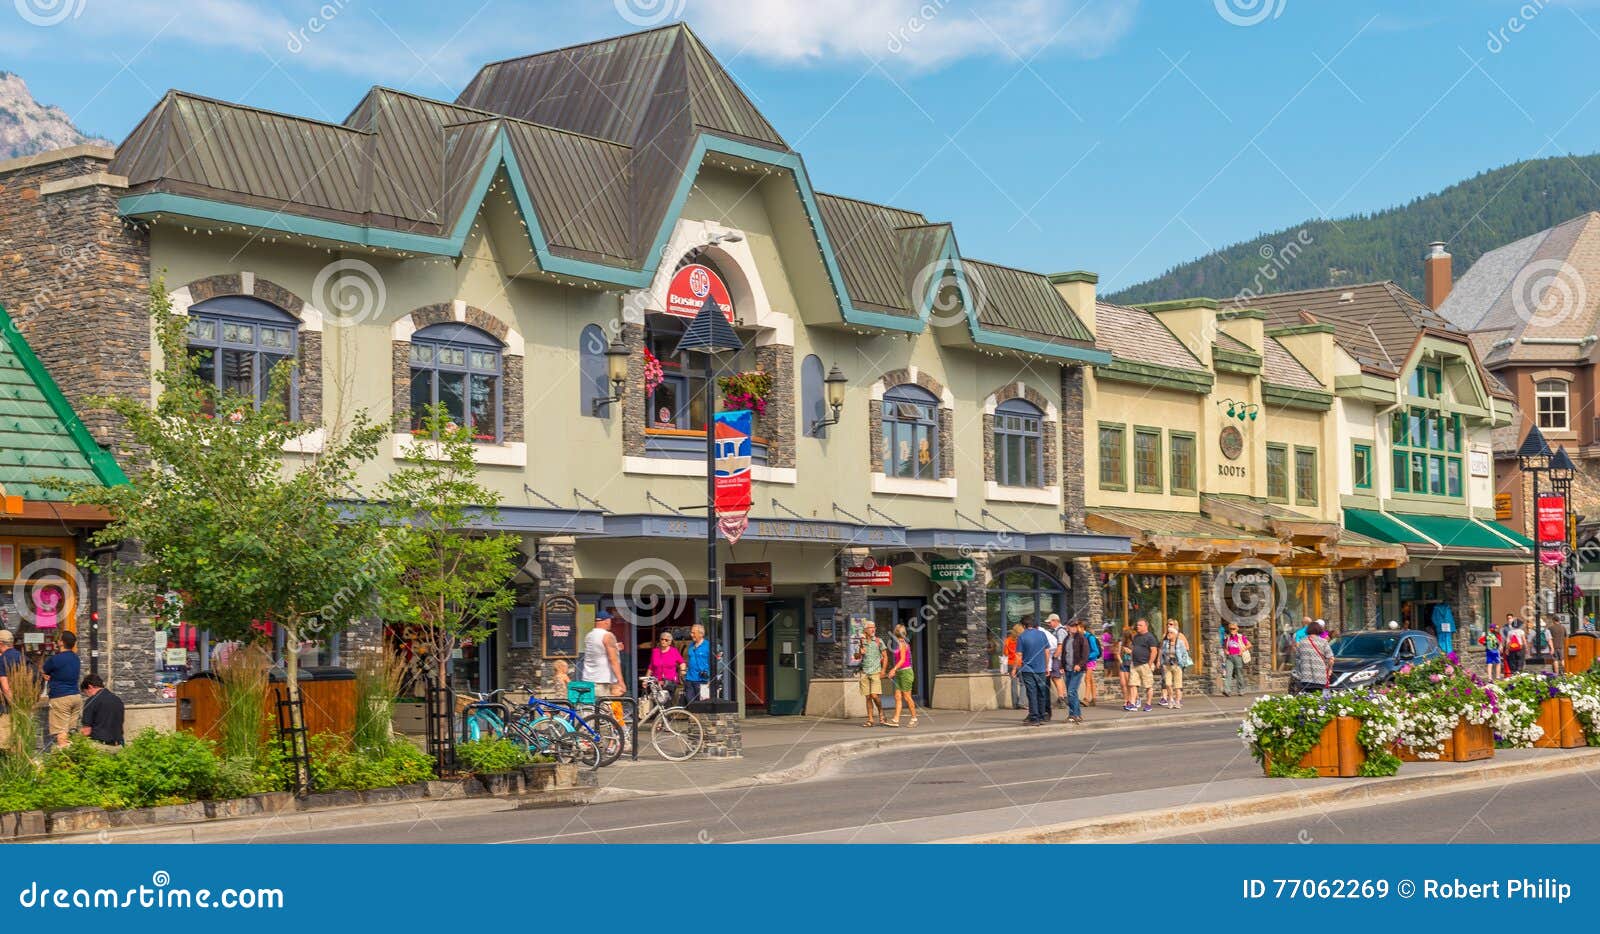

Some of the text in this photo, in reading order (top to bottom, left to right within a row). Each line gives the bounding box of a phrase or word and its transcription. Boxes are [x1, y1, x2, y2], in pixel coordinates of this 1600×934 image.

[670, 294, 704, 308] Boston
[1218, 464, 1246, 478] ROOTS
[1226, 571, 1270, 584] Roots
